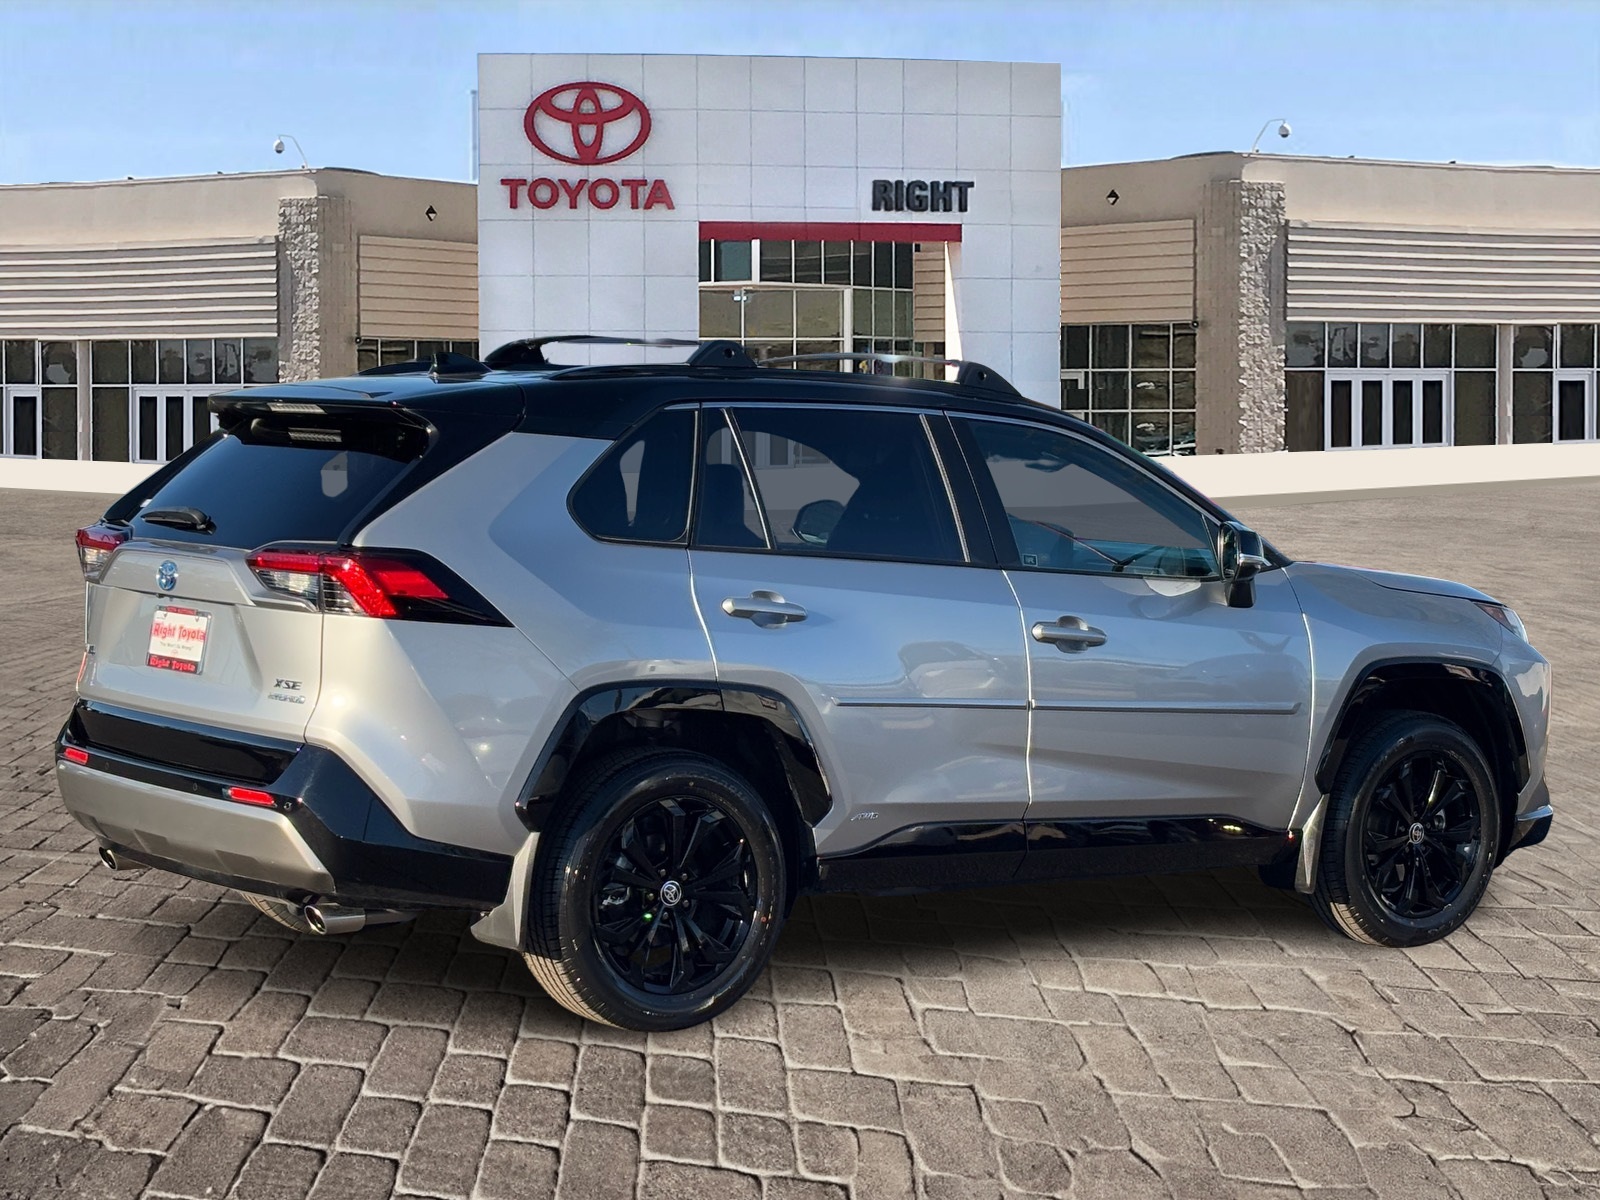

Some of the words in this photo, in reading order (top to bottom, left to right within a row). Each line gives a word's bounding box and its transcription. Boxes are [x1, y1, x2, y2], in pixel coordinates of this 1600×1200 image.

[500, 179, 675, 210] TOYOTA
[872, 179, 975, 212] RIGHT
[153, 622, 176, 639] Right
[178, 625, 206, 642] Toyota
[149, 656, 170, 668] Right
[172, 660, 196, 672] Toyota
[273, 678, 302, 691] XSE
